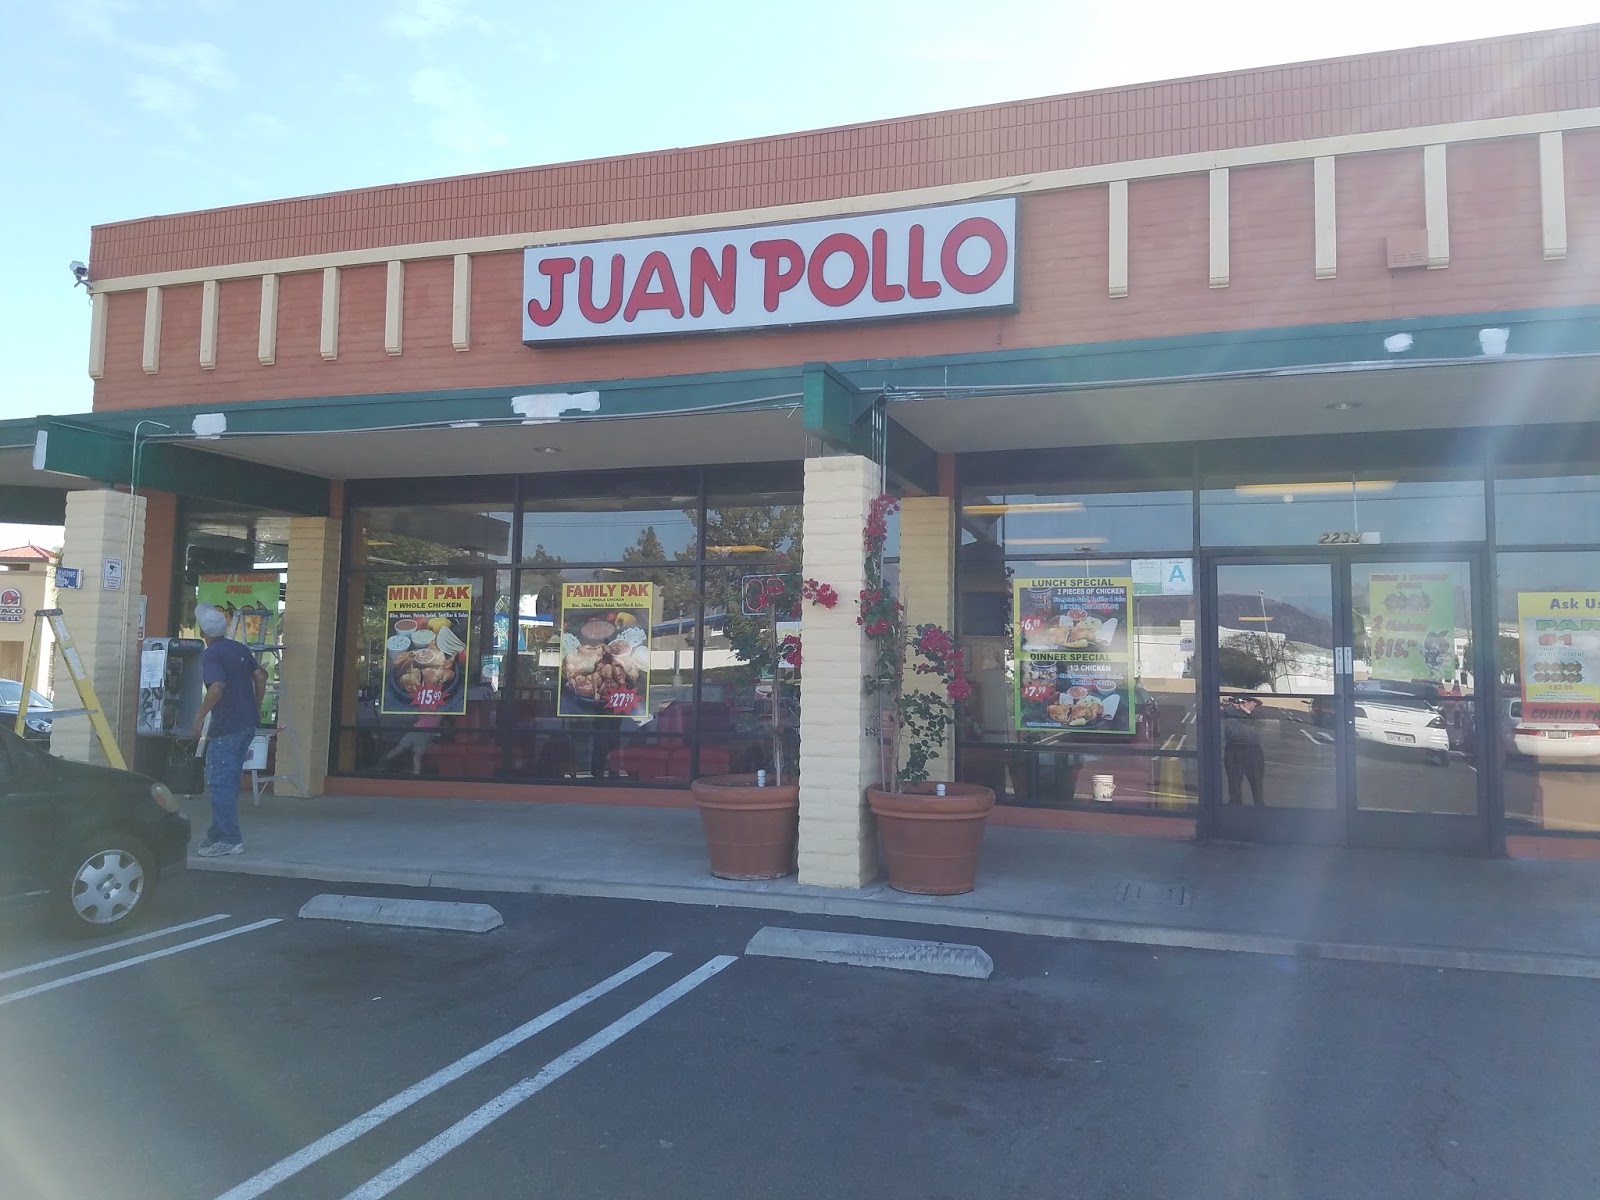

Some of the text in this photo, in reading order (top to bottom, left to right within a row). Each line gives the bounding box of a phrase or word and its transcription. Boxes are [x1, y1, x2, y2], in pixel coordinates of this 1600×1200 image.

[528, 217, 1008, 327] JUAN POLLO
[1319, 532, 1359, 544] 2233
[57, 569, 76, 578] PHONE
[1168, 564, 1186, 582] A
[1069, 578, 1114, 587] SPECIAL
[389, 586, 470, 600] MINI PAK
[566, 583, 649, 597] FAMILY PAK
[1550, 598, 1579, 609] Ask
[1021, 619, 1041, 630] $6.99
[1030, 653, 1112, 661] DINNER SPECIAL
[1080, 664, 1111, 672] CHICKEN
[1024, 686, 1046, 697] $7.99
[1531, 708, 1581, 720] COMIDA
